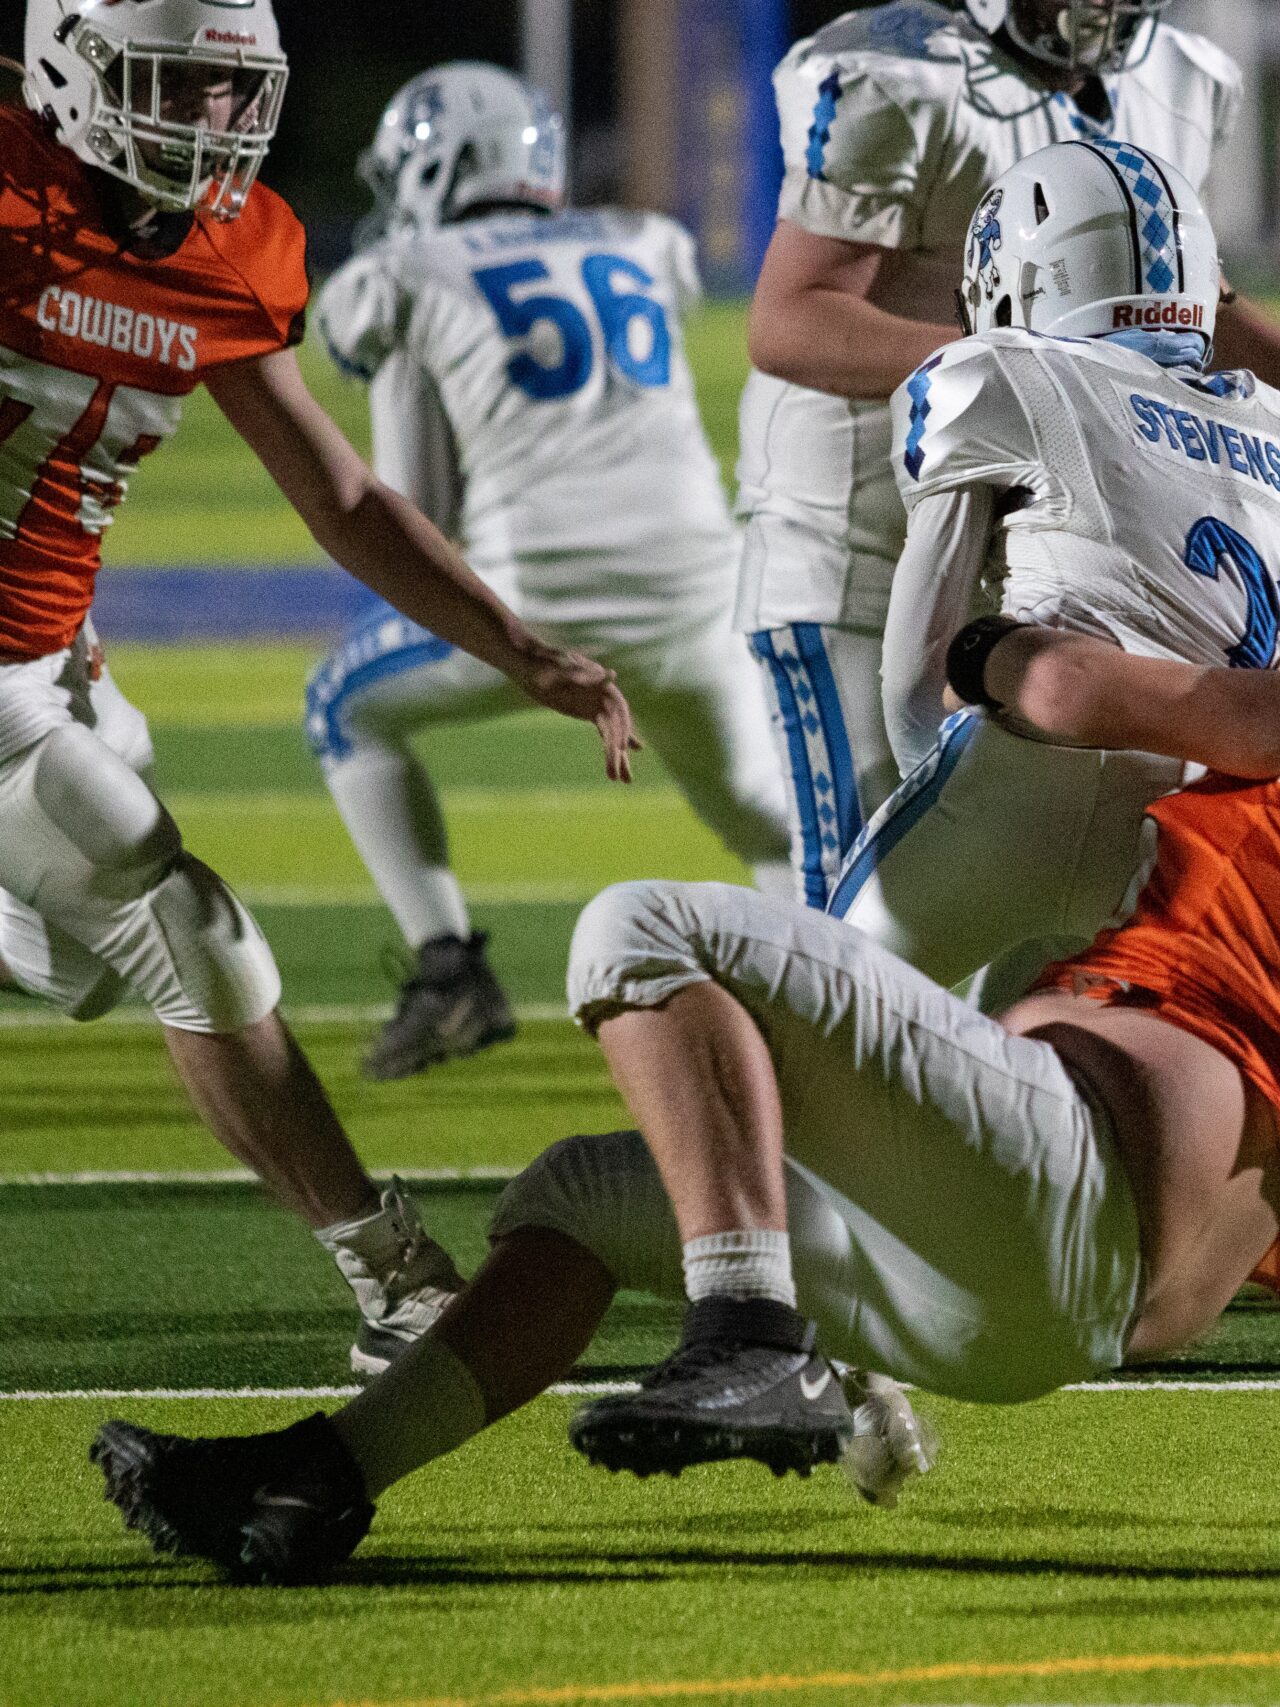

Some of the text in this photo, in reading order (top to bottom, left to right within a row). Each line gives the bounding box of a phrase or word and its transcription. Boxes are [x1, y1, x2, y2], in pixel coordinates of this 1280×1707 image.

[37, 286, 197, 371] COWBOYS
[472, 253, 672, 401] 56
[1112, 302, 1204, 329] Riddell
